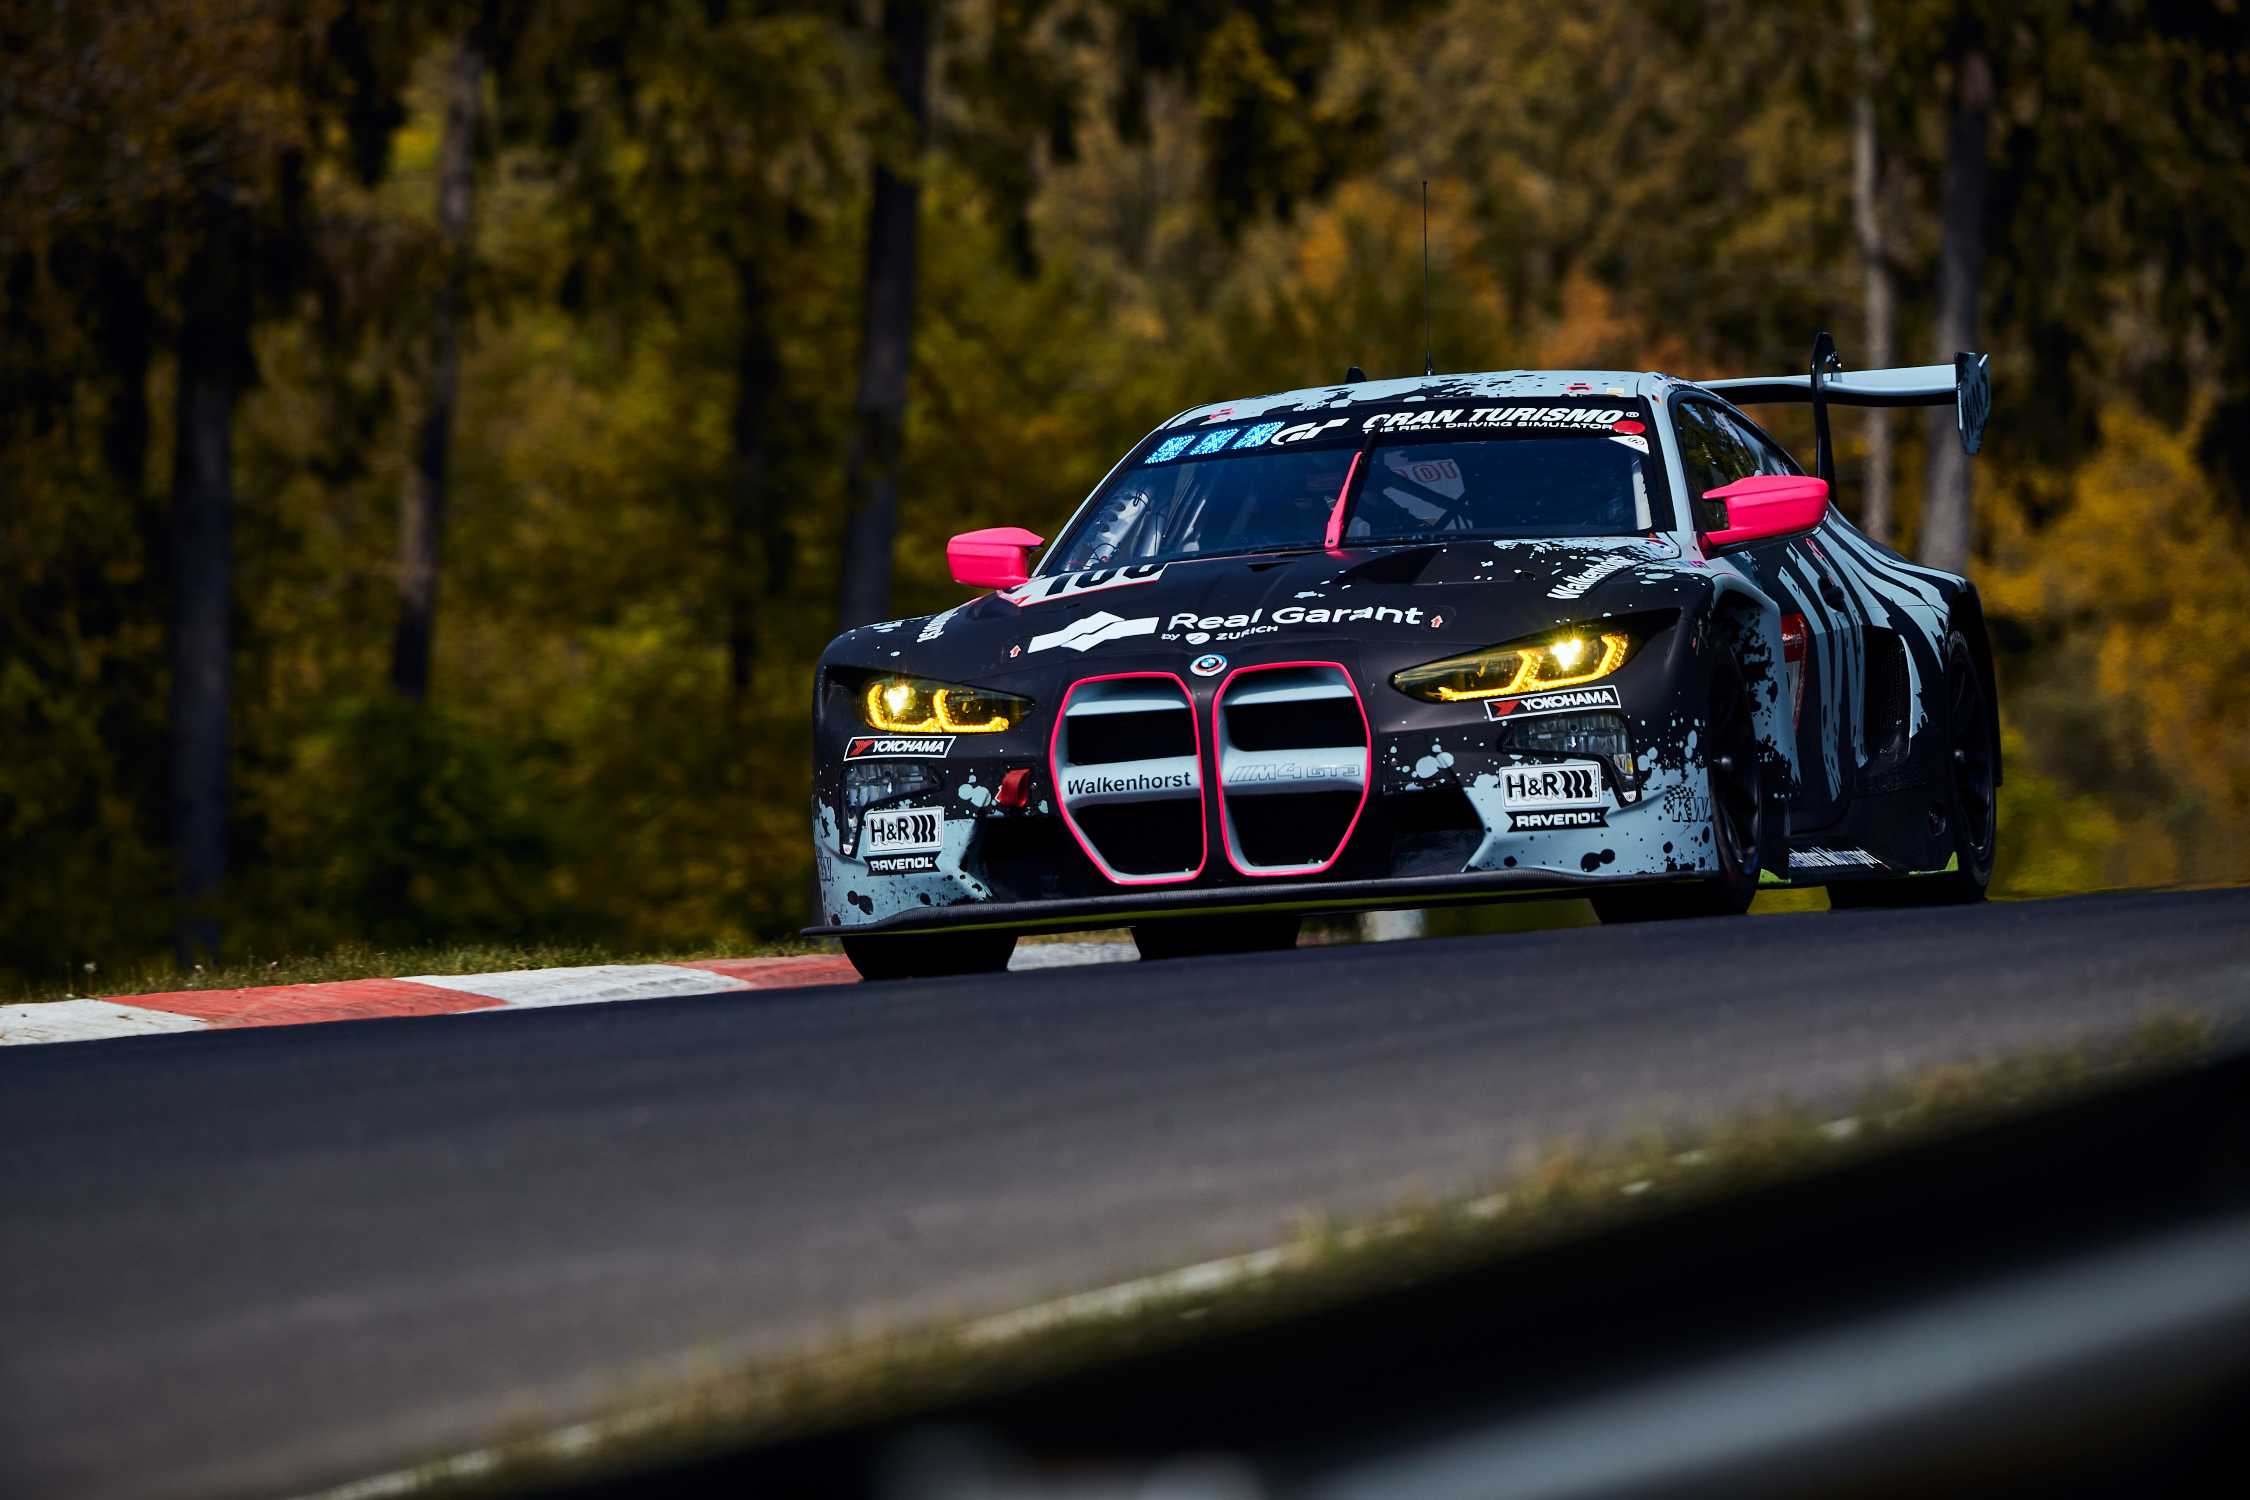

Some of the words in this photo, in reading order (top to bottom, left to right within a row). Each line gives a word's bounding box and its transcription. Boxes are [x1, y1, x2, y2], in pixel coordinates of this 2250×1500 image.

[1362, 408, 1464, 429] GRAN
[1469, 407, 1625, 424] TURISMO
[1398, 423, 1452, 432] REAL
[1452, 420, 1516, 430] DRIVING
[1516, 420, 1613, 431] SIMULATOR
[1167, 608, 1264, 631] Real
[1271, 605, 1424, 626] Garant
[1161, 632, 1181, 642] by
[1215, 624, 1279, 641] ZURICH
[1520, 689, 1614, 711] YOKOHAMA
[872, 740, 946, 753] YOKOHAMA
[1066, 770, 1192, 795] Walkenhorst
[1506, 771, 1560, 799] H&R
[1515, 812, 1601, 829] RAVENOL
[1672, 796, 1712, 823] KW
[871, 817, 910, 843] H&R
[869, 856, 934, 872] RAVENOL
